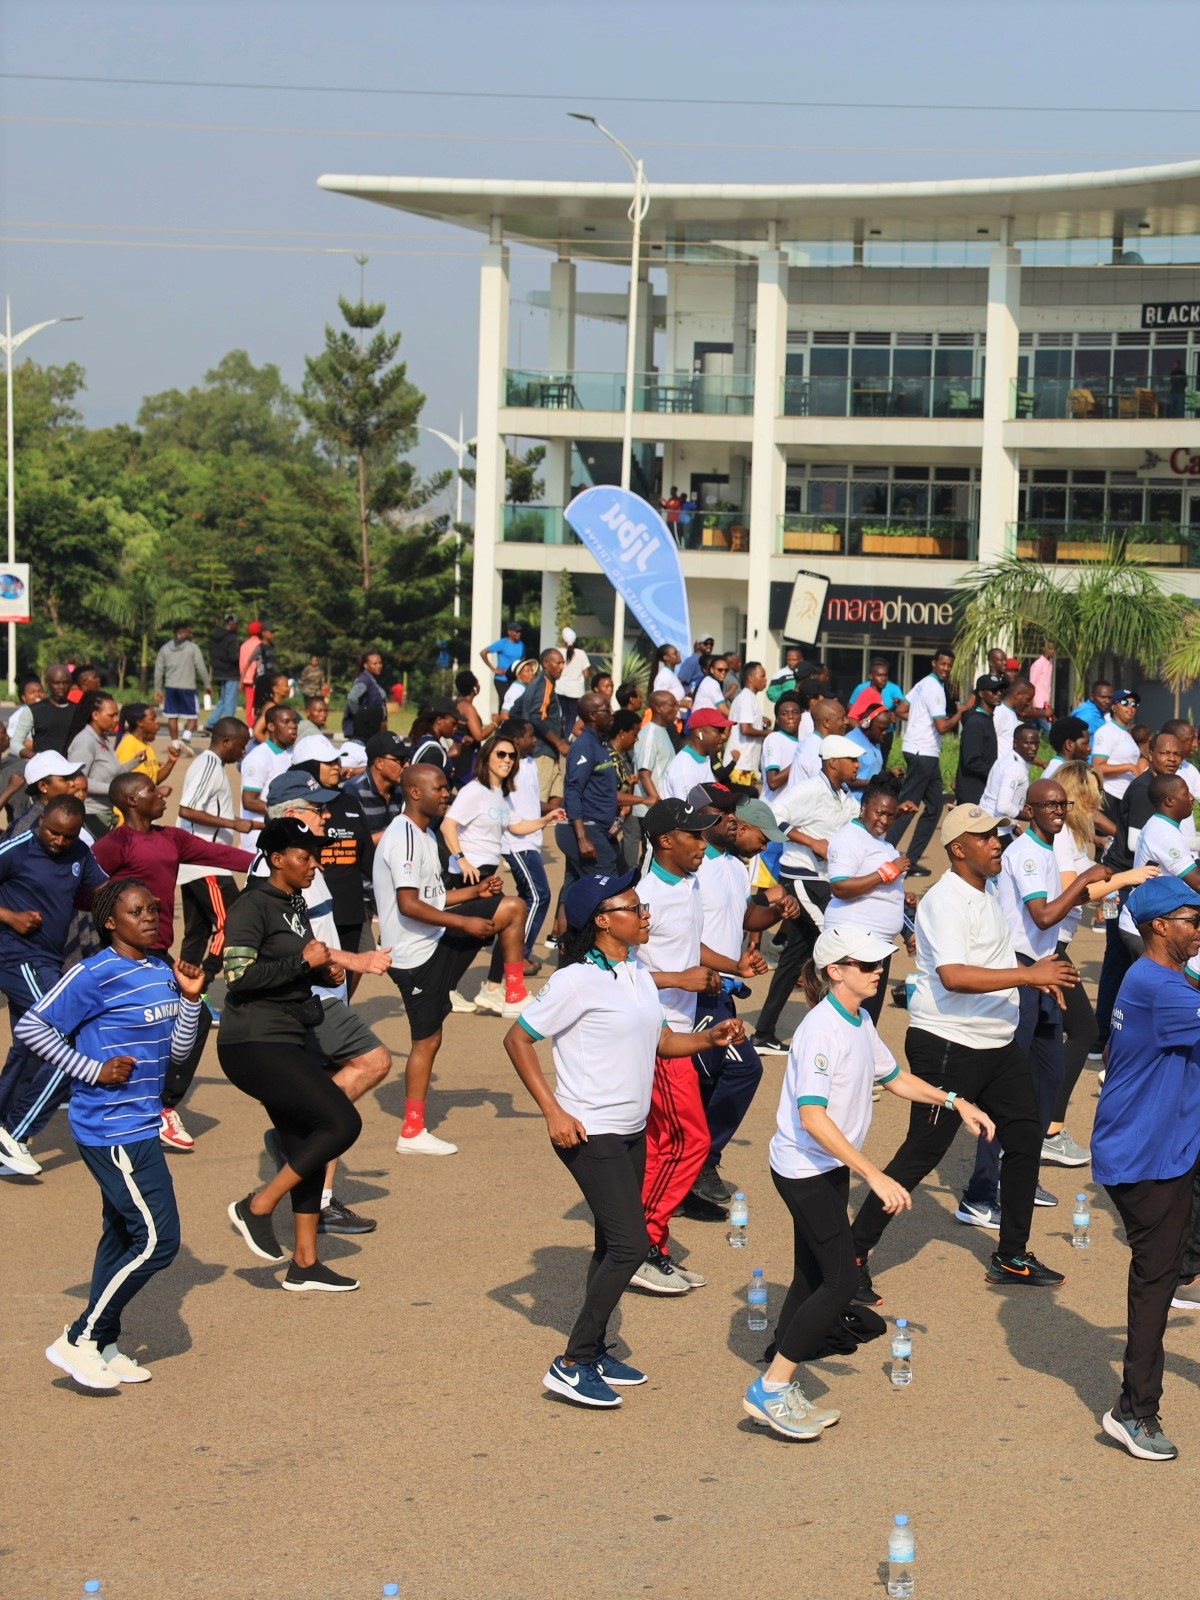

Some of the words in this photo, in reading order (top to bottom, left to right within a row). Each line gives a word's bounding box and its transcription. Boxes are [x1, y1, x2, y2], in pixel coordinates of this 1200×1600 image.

[827, 595, 953, 630] maraphone
[320, 856, 336, 865] gap
[144, 1002, 179, 1022] SAMSUN
